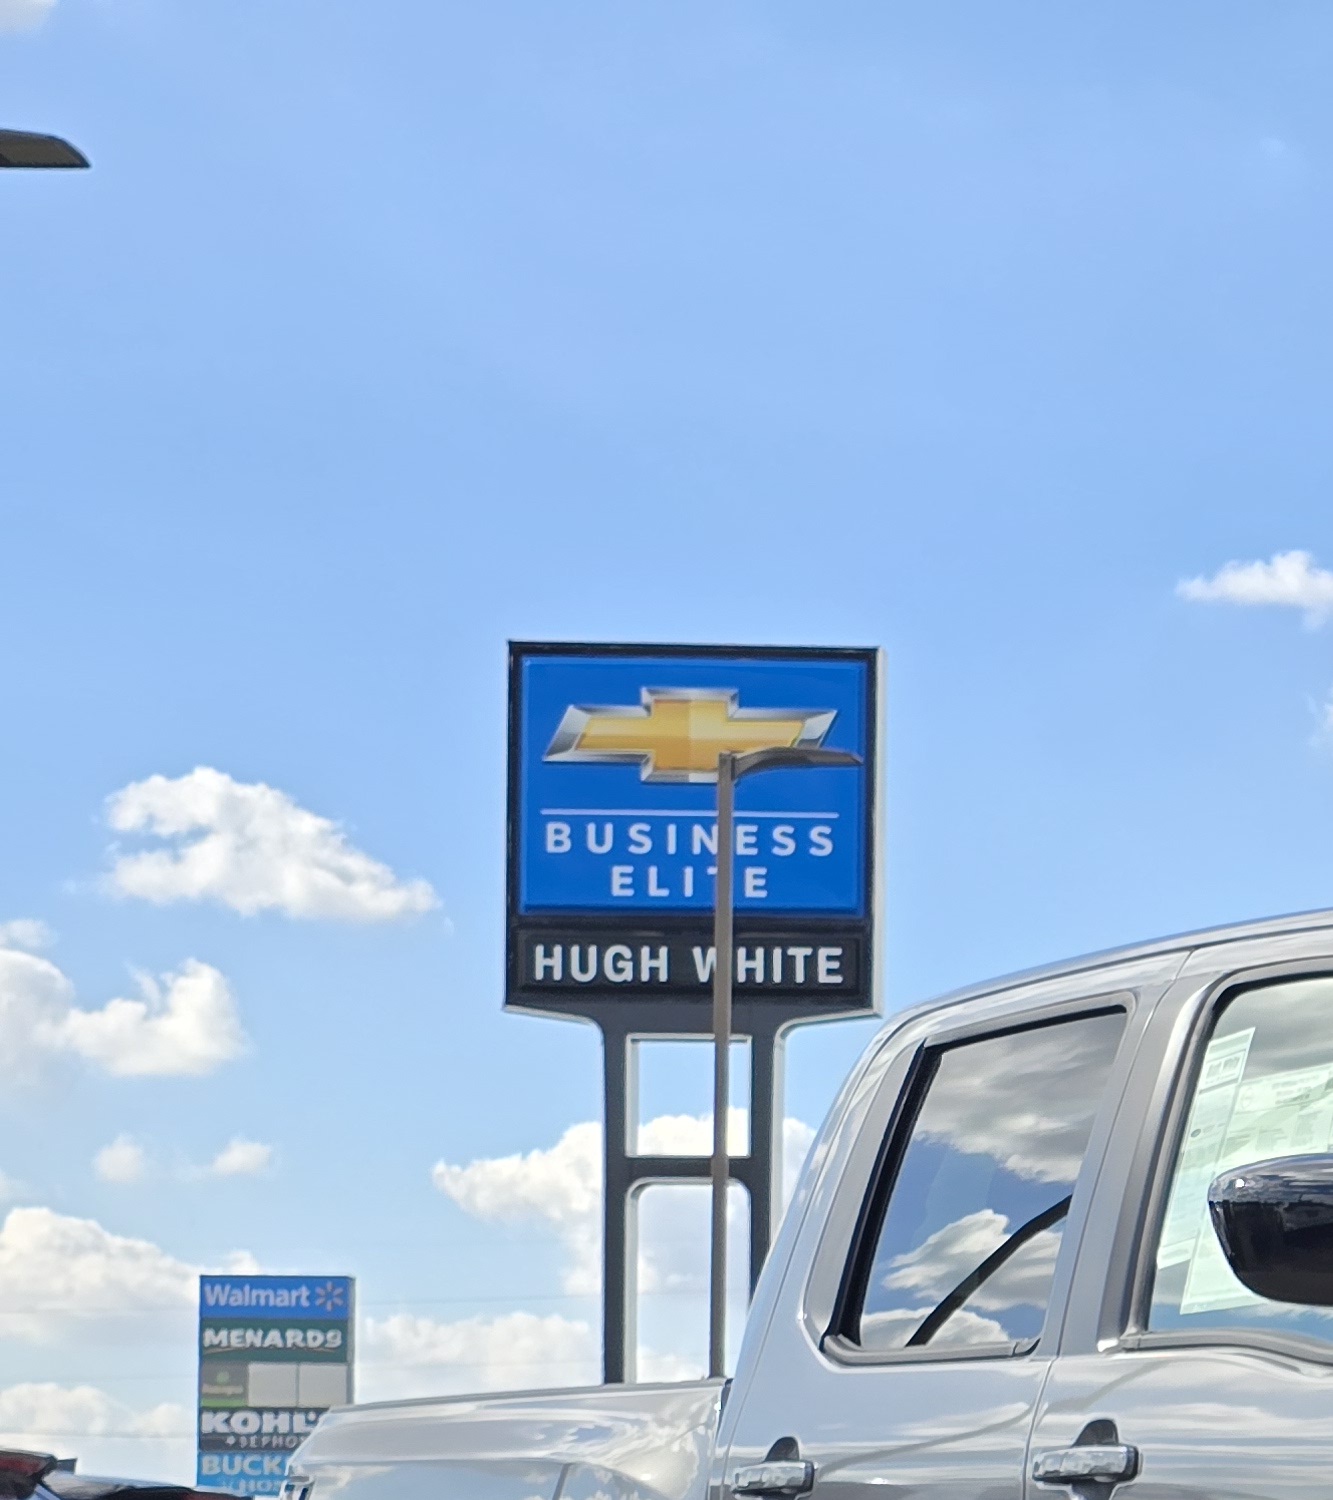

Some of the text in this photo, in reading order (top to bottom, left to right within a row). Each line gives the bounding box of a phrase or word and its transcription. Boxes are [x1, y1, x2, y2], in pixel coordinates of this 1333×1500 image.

[546, 821, 834, 857] BUSINESS
[534, 944, 669, 983] HUGH
[204, 1283, 311, 1307] Walmart
[202, 1327, 342, 1349] MENARDS
[202, 1410, 320, 1434] KOHL'
